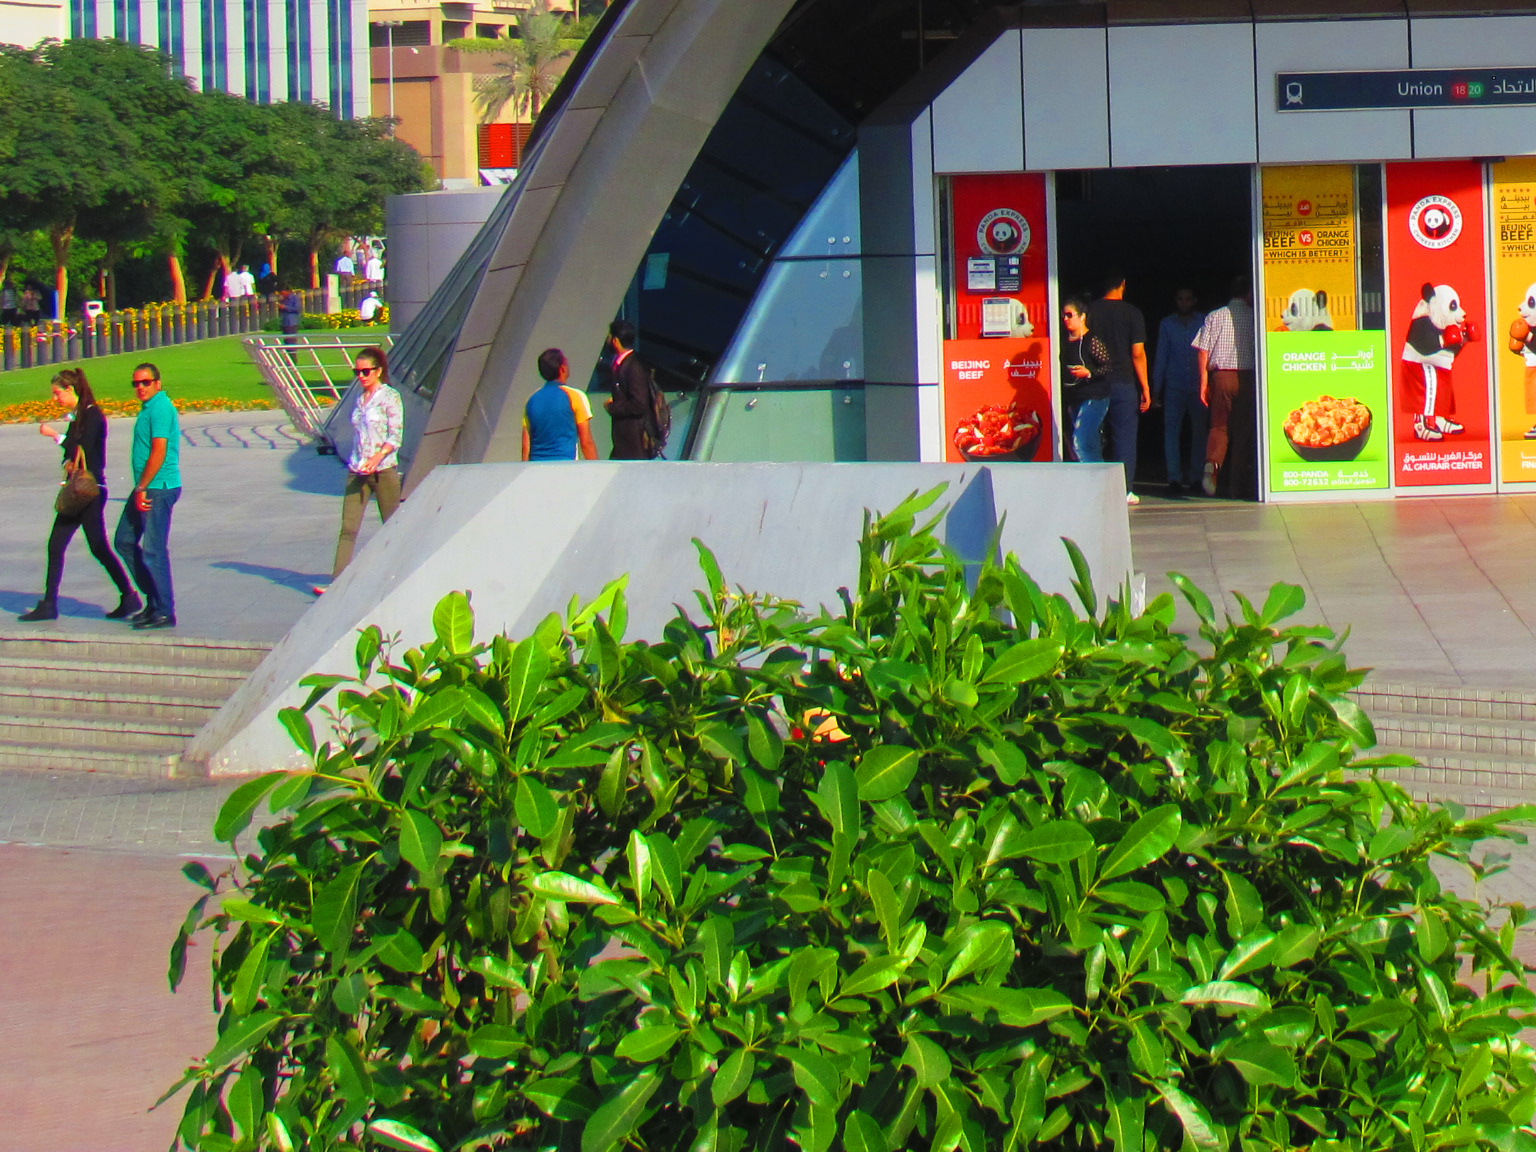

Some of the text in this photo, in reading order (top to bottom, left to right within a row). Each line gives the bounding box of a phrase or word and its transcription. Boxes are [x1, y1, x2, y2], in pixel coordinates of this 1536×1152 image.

[1398, 82, 1443, 96] Union
[1455, 86, 1481, 95] 18 20
[1411, 196, 1460, 220] PANDA EXPRESS
[979, 210, 1028, 233] PANDA EXPRESS
[1301, 234, 1312, 242] VS
[1414, 228, 1458, 246] CHINESE KITCHEN
[1501, 230, 1533, 241] BEEF
[1264, 237, 1295, 248] BEEF
[1283, 352, 1326, 361] ORANGE
[1331, 345, 1374, 360] أورانج
[951, 360, 990, 370] BEIJING
[1004, 359, 1042, 369] بيجينغ
[1282, 362, 1326, 371] CHICKEN
[1331, 360, 1374, 371] تشيكن
[959, 371, 984, 380] BEEF
[1011, 369, 1035, 378] بيف
[1403, 452, 1483, 463] مركز الغرير للتسوق
[1402, 461, 1483, 472] AL GHURAIR CENTER
